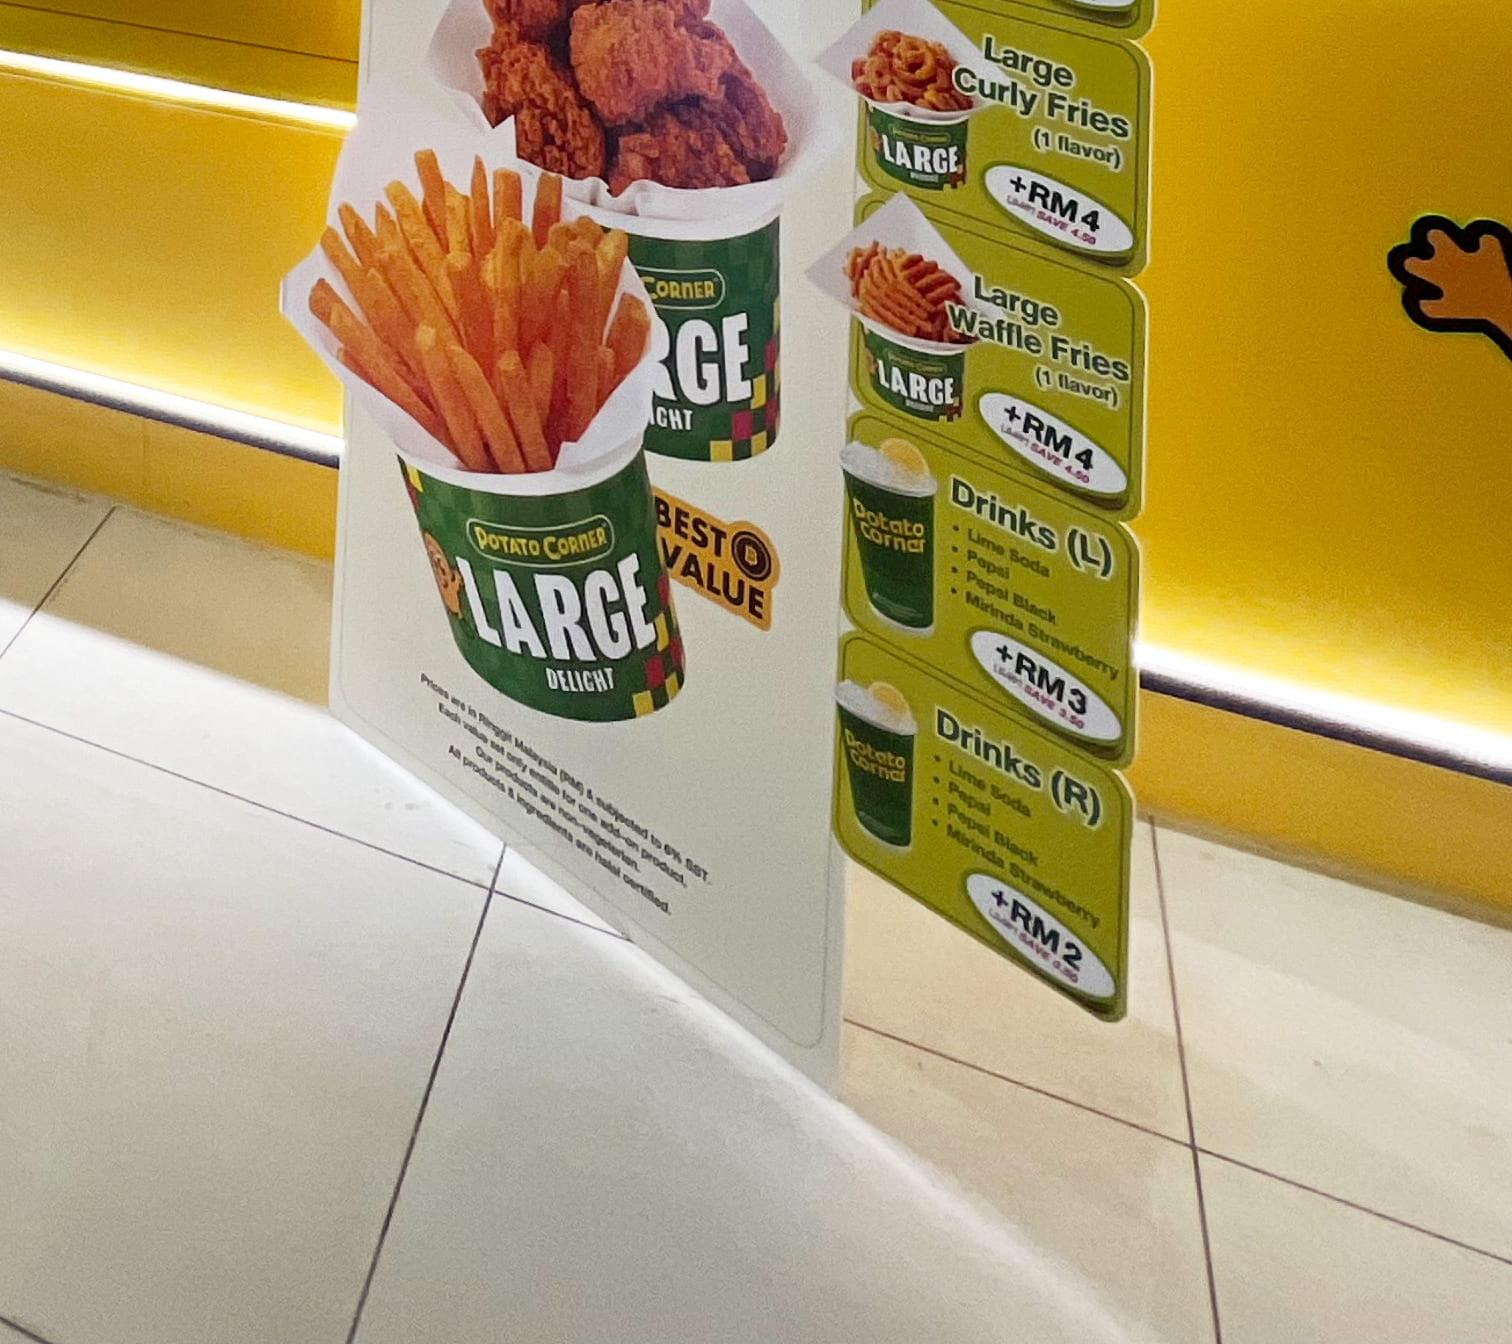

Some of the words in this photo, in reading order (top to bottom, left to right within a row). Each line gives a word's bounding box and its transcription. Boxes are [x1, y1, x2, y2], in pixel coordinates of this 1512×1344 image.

[985, 36, 1074, 87] Large
[954, 66, 1038, 116] Curly
[1048, 95, 1130, 139] Fries
[882, 134, 959, 174] LARGE
[1036, 210, 1070, 232] SAVE
[974, 274, 1059, 326] Large
[949, 303, 1042, 355] Waffle
[1052, 336, 1131, 383] Fries
[877, 359, 955, 406] LARGE
[1030, 442, 1063, 466] SAVE
[475, 526, 541, 558] POTATO
[544, 518, 609, 557] CORNER
[654, 497, 728, 559] BEST
[853, 498, 925, 537] Potato
[952, 477, 1057, 550] Drinks
[1067, 526, 1113, 577] (L)
[660, 536, 765, 620] VALUE
[966, 548, 1011, 580] Pepsi
[967, 528, 1006, 556] Lime
[1009, 546, 1051, 579] Soda
[455, 554, 656, 663] LARGE
[966, 570, 1010, 602] Pepsi
[1013, 592, 1058, 626] Black
[1028, 622, 1120, 681] Strawberry
[545, 667, 615, 693] DELIGHT
[936, 709, 1042, 789] Drinks
[1051, 770, 1102, 828] (R)
[949, 759, 986, 791] Lime
[990, 782, 1032, 819] Soda
